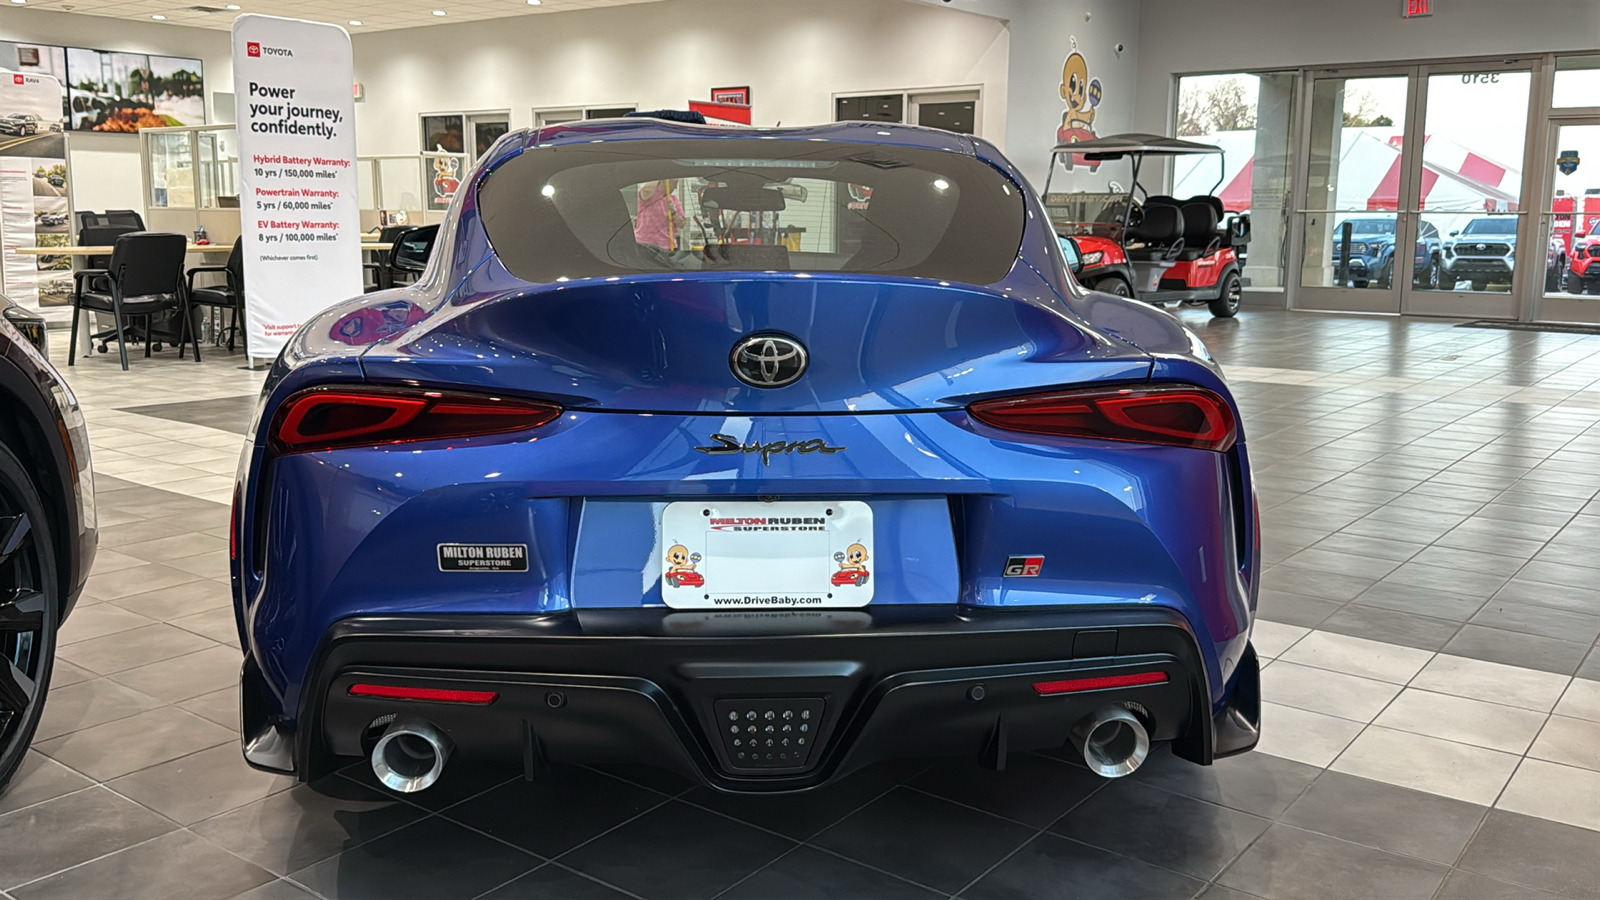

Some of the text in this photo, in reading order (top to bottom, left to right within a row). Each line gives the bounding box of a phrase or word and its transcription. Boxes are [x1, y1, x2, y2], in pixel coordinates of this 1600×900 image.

[262, 47, 293, 57] TOYOTA
[249, 82, 295, 99] Power
[250, 102, 343, 123] your journey,
[251, 120, 337, 140] confidently.
[253, 155, 351, 168] Hybrid Battery Warranty:
[254, 168, 263, 176] 10
[265, 170, 277, 178] yrs
[284, 169, 314, 179] 150,000
[255, 188, 339, 199] Powertrain Warranty:
[256, 201, 261, 209] 5
[263, 202, 276, 211] yrs
[283, 202, 309, 211] 60,000
[257, 221, 340, 230] EV Battery Warranty:
[258, 233, 264, 241] 8
[266, 235, 278, 243] yrs
[285, 233, 315, 243] 100,000
[693, 433, 847, 467] Supra
[442, 547, 523, 558] MILTON RUBEN
[1006, 564, 1040, 575] GR
[714, 596, 822, 606] www.DriveBaby.com
